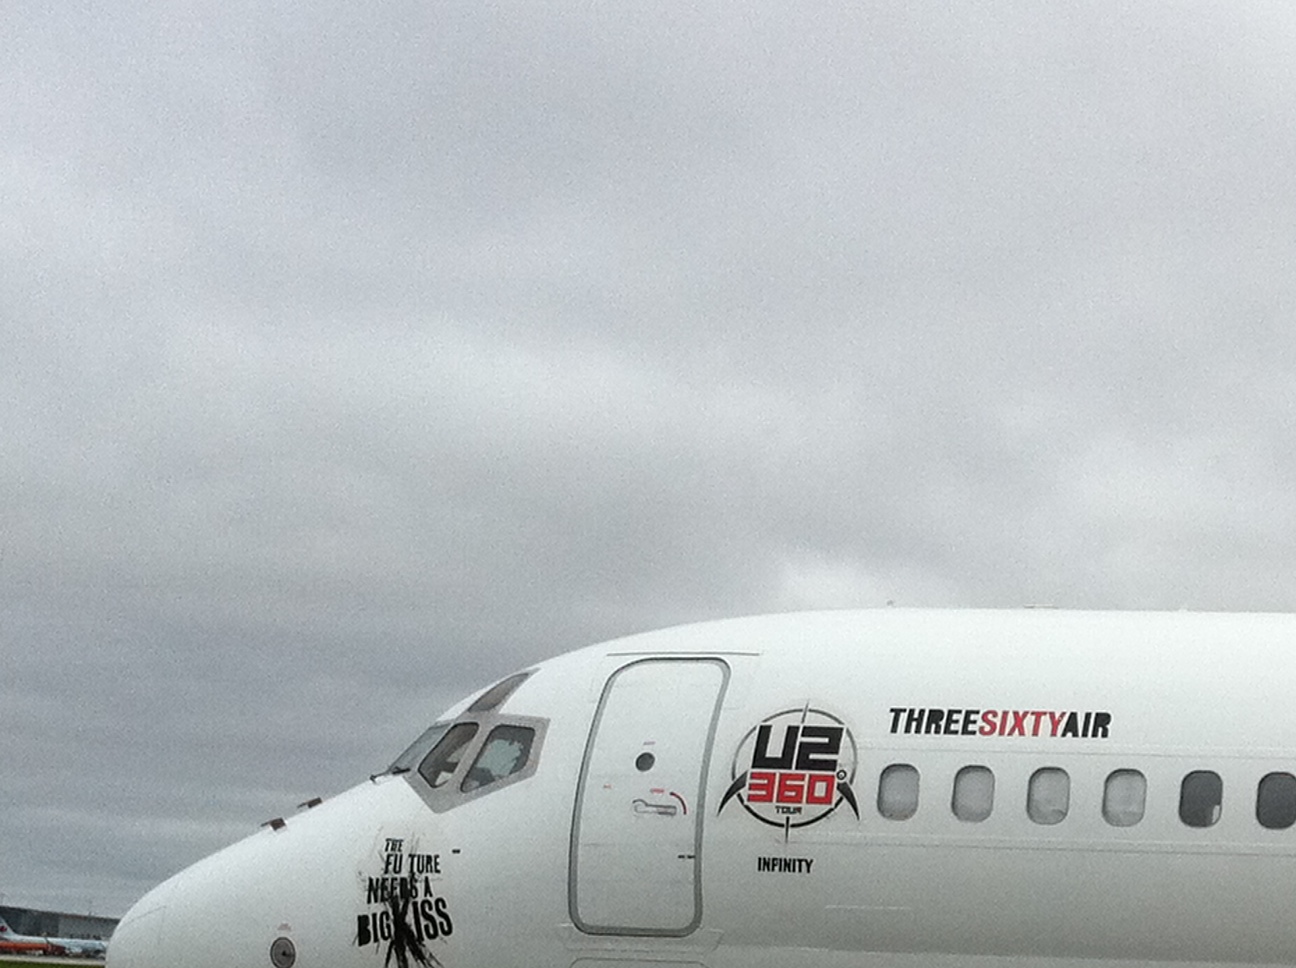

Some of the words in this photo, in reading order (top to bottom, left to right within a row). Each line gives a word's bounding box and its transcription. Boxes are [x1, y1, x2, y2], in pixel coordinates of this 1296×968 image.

[751, 725, 845, 772] U2
[775, 805, 803, 815] TOUR
[384, 838, 404, 853] THE
[757, 856, 814, 874] INFINITY
[367, 876, 418, 904] NEEDS
[423, 876, 433, 898] A
[357, 911, 391, 947] BIG
